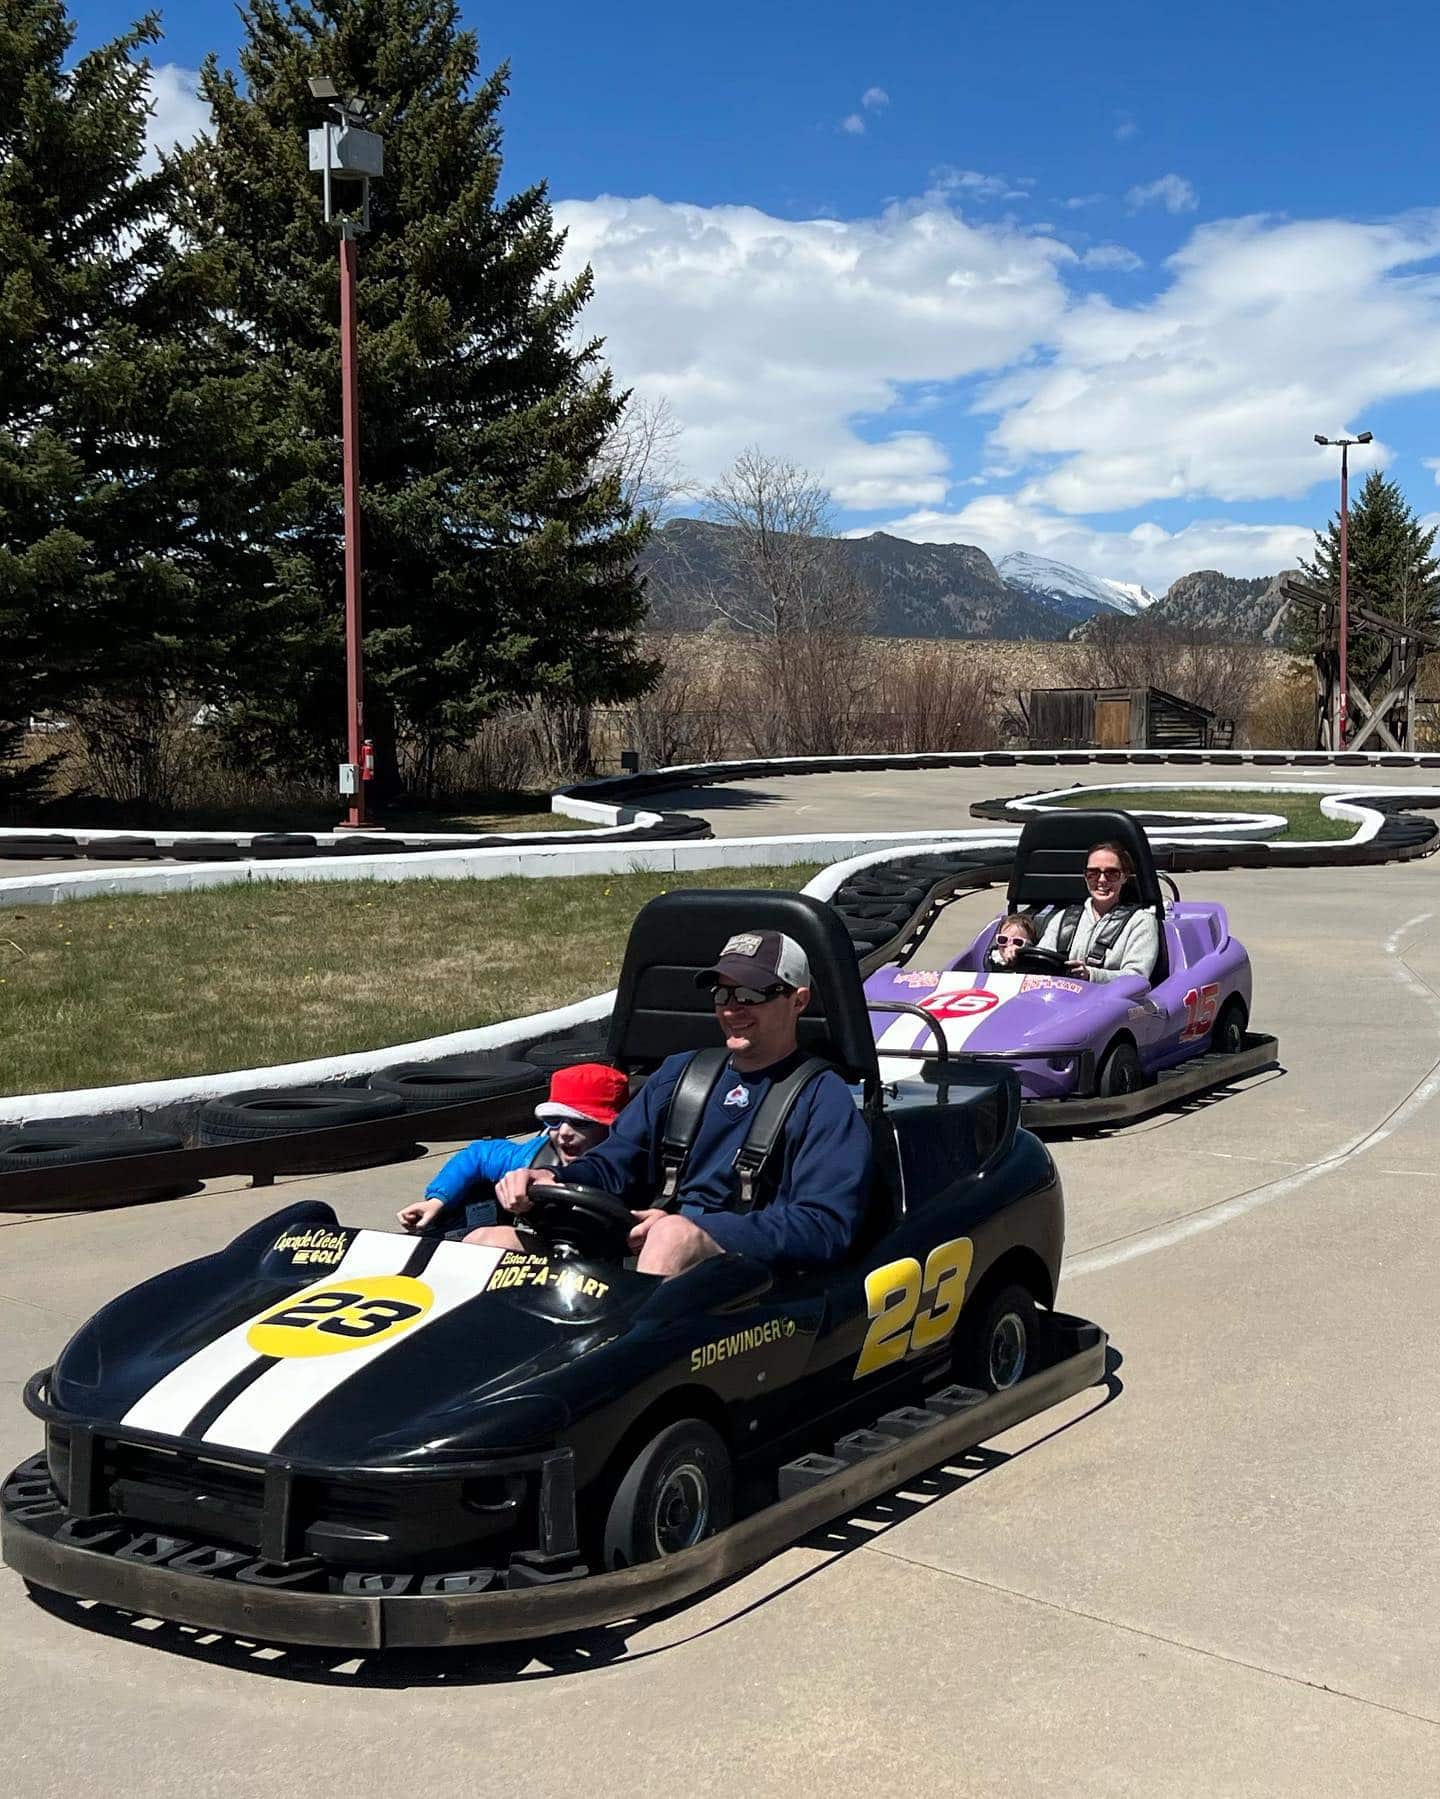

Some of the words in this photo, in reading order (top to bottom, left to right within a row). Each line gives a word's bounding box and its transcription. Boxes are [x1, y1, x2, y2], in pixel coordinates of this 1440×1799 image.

[1178, 982, 1219, 1042] 15
[309, 1250, 345, 1265] GOLF
[310, 1229, 347, 1252] Creek
[259, 1292, 422, 1337] 23
[854, 1236, 975, 1381] 23
[691, 1319, 781, 1372] SIDEWINDER
